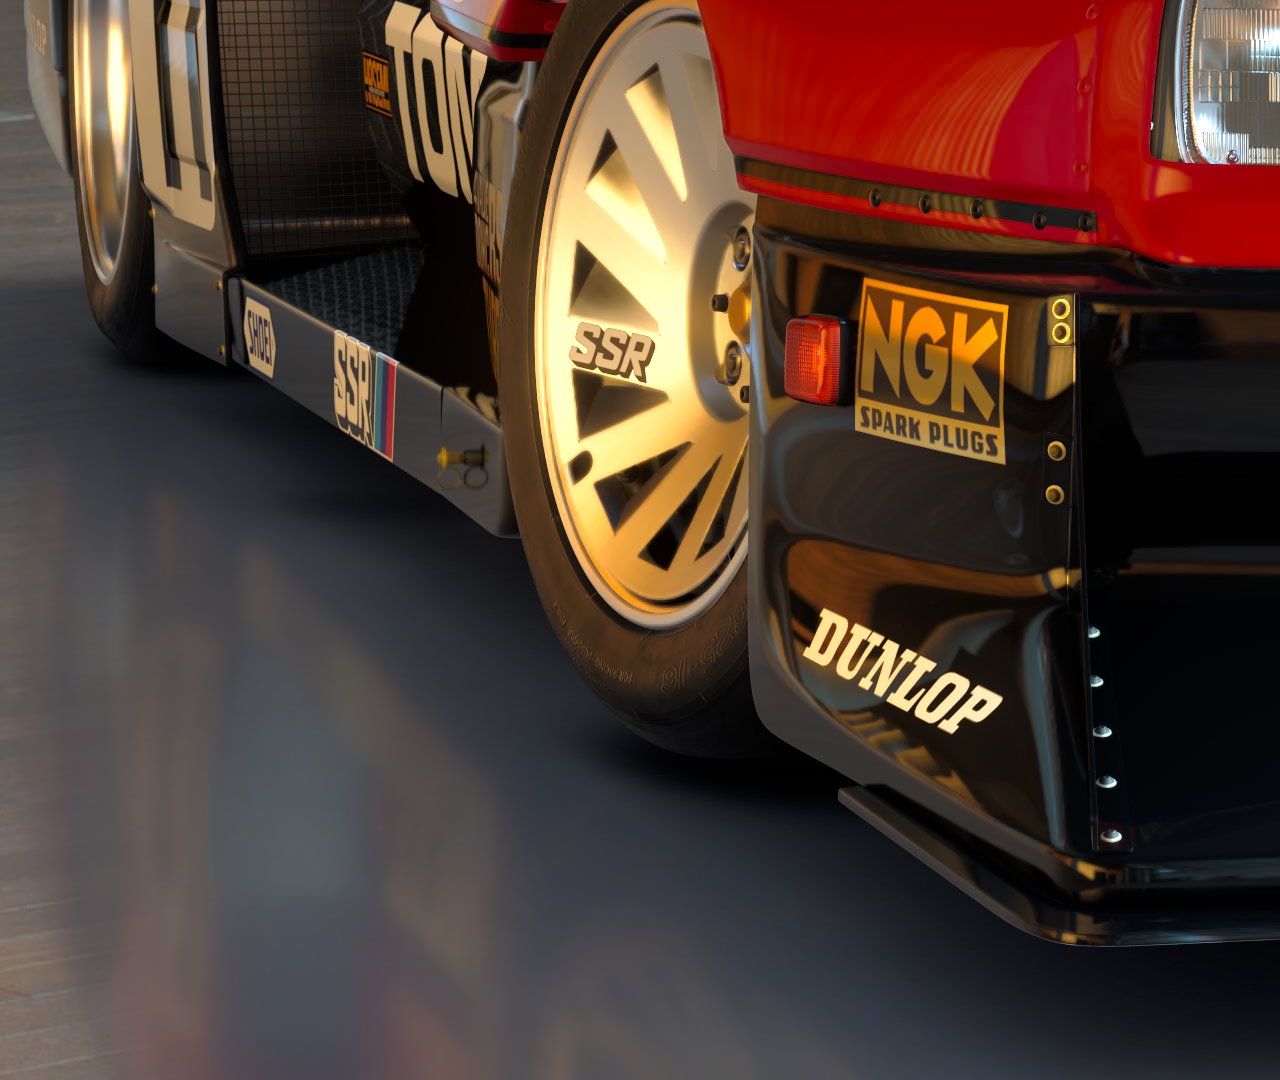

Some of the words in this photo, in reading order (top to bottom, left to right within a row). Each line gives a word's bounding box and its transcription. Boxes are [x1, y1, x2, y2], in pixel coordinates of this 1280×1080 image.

[247, 309, 273, 367] SHOEI
[569, 322, 655, 383] SSR
[861, 293, 998, 422] NGK
[334, 330, 375, 448] SSR
[860, 405, 921, 441] SPARK
[928, 421, 998, 457] PLUGS
[803, 608, 1003, 735] DUNLOP
